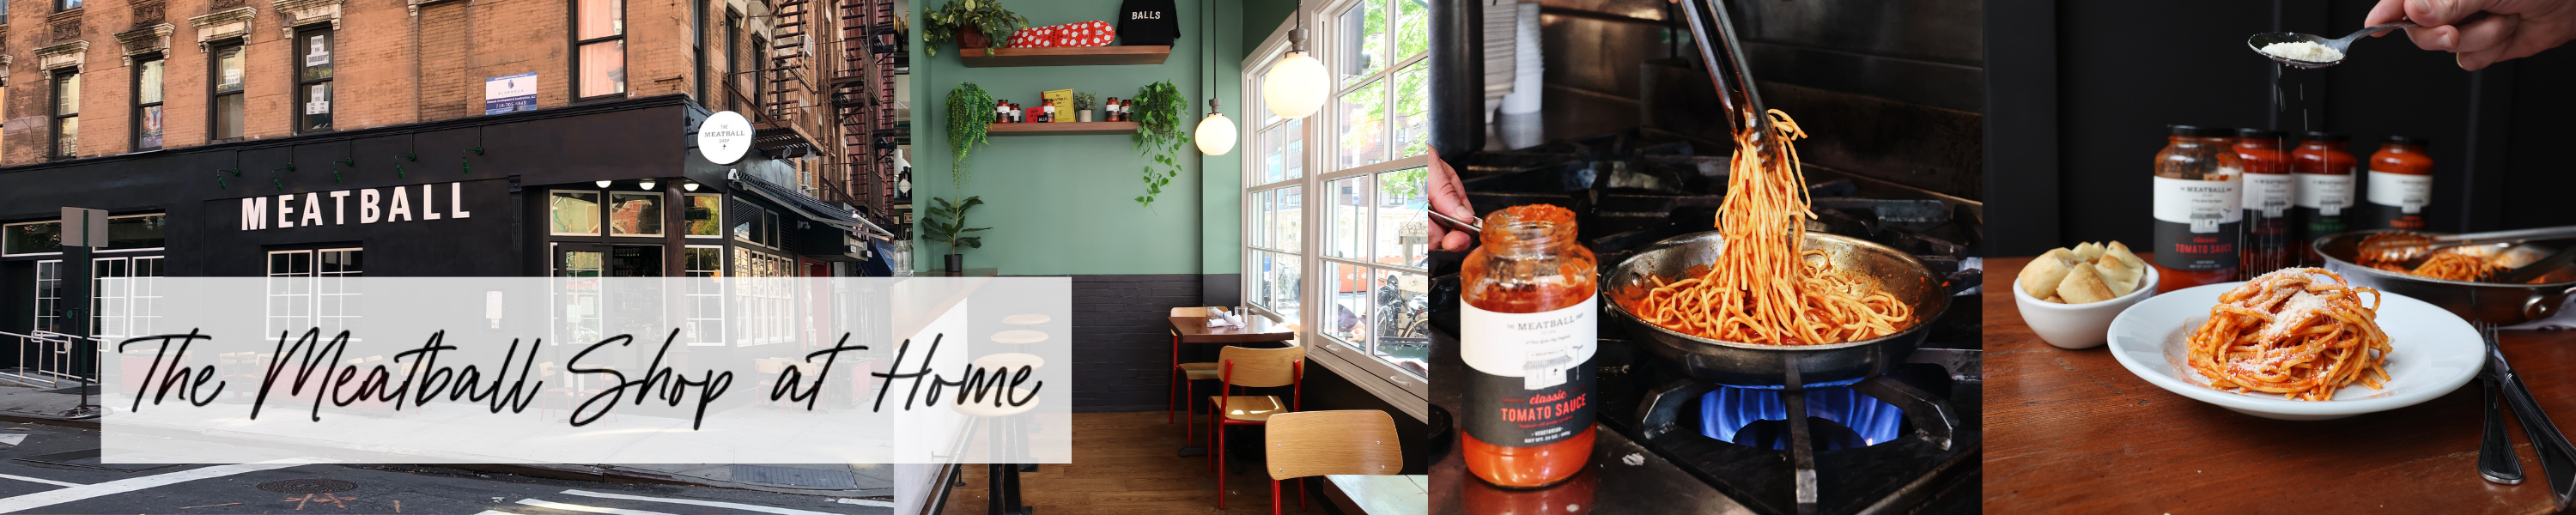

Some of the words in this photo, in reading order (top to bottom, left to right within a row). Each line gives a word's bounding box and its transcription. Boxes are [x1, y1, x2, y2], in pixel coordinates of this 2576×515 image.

[1132, 11, 1161, 20] BALLS
[241, 182, 470, 231] MEATBALL
[2175, 243, 2208, 254] TOMATO
[2209, 243, 2233, 254] SAUCE
[1518, 315, 1575, 330] MEATBALL
[1529, 389, 1567, 405] classic
[1501, 405, 1552, 422] TOMATO
[1555, 392, 1587, 417] SAUCE
